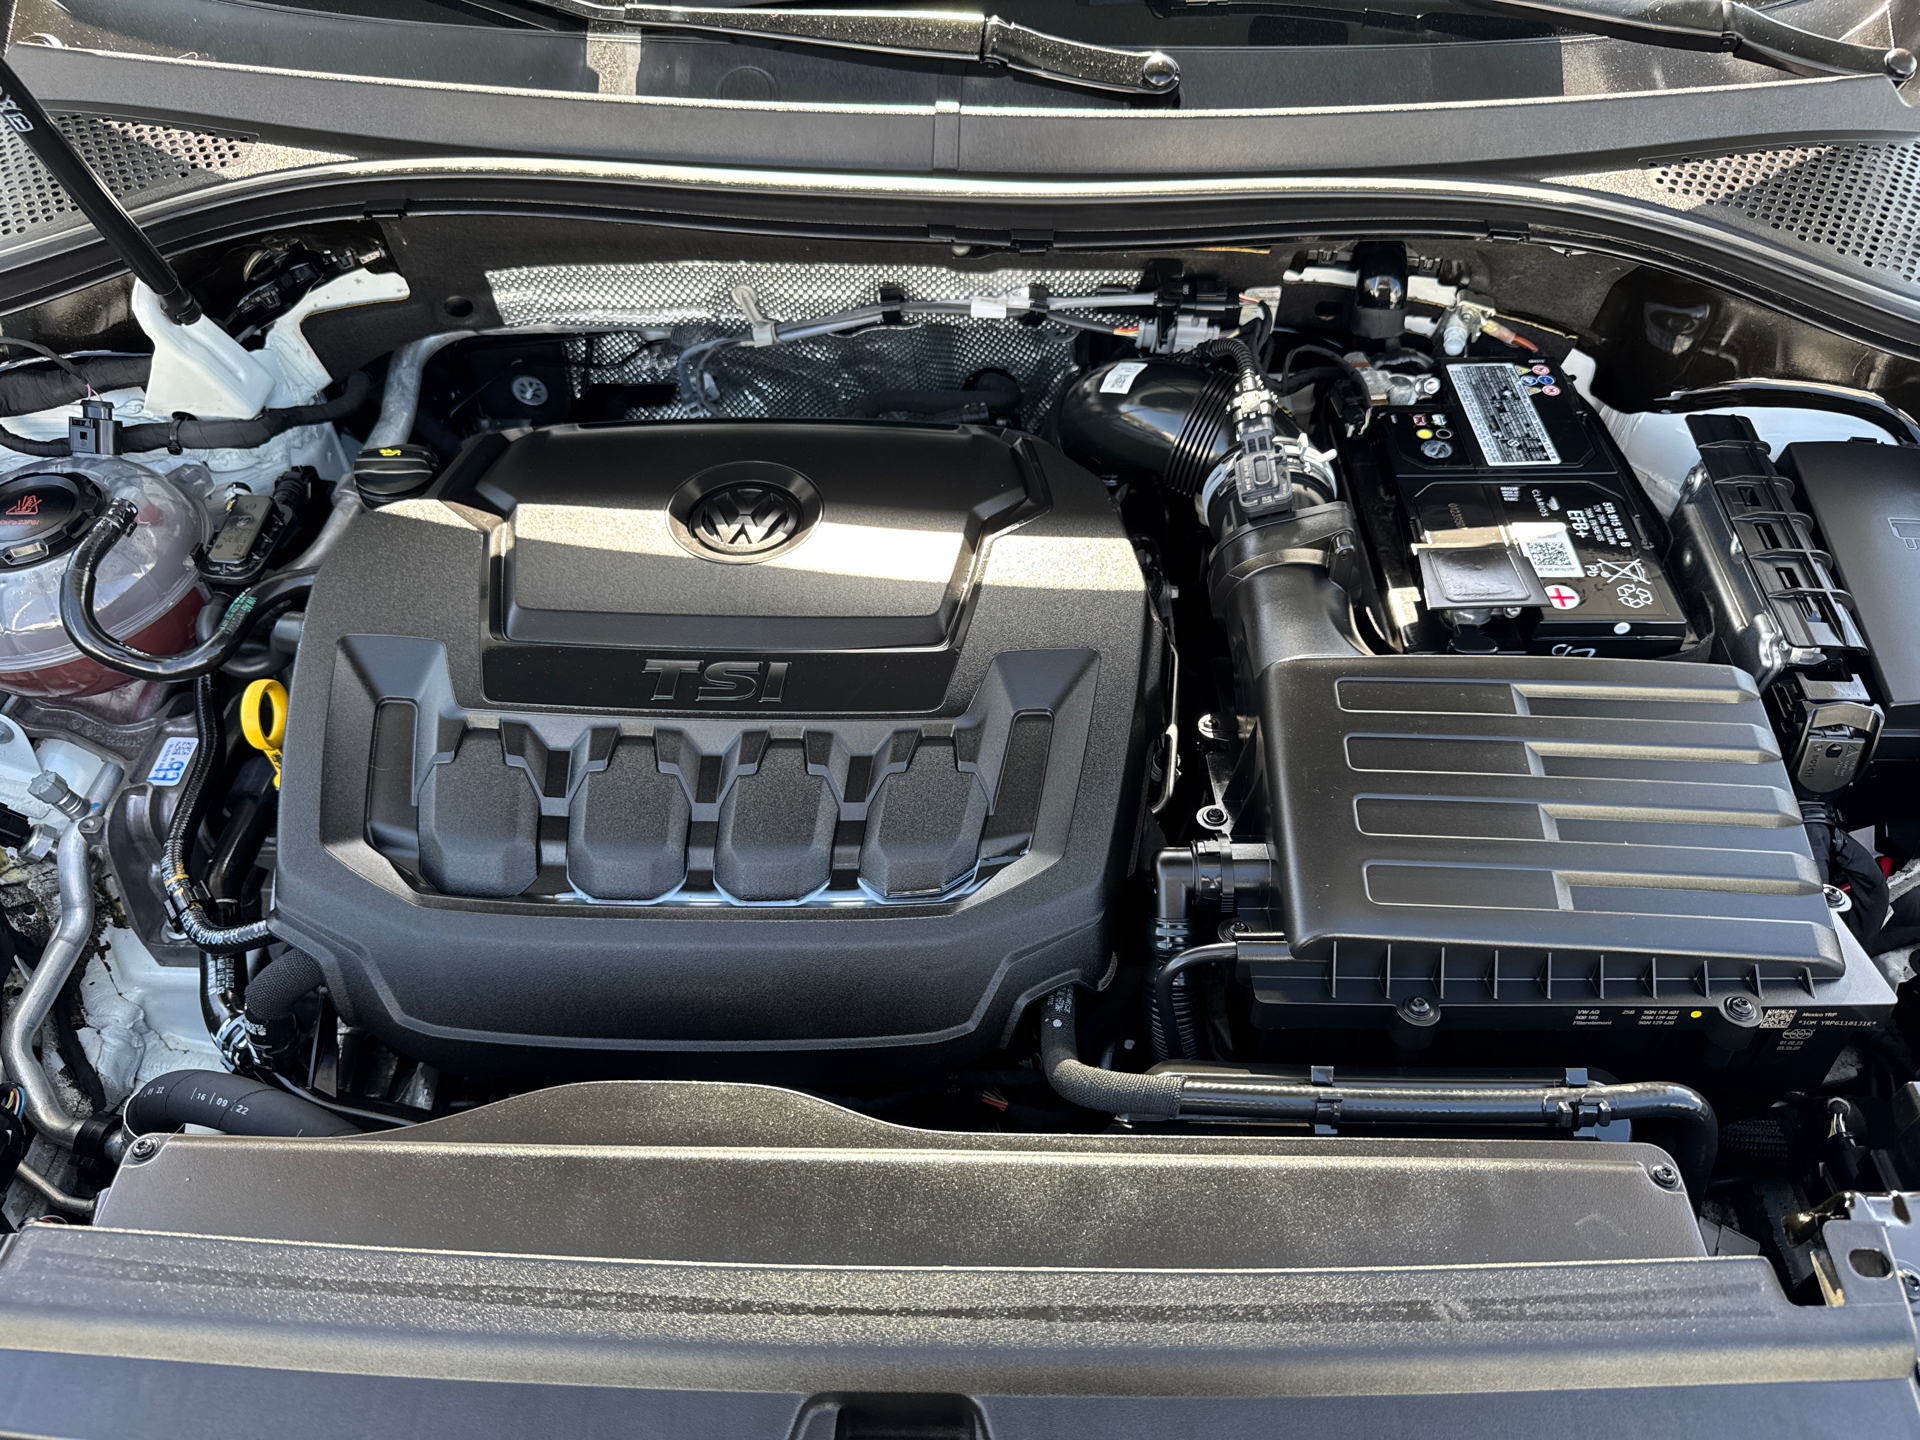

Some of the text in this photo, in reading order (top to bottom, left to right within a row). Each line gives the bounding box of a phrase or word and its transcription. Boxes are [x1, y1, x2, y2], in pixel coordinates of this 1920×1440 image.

[1532, 489, 1550, 517] CLARIOS
[1602, 502, 1616, 514] 5TA
[1566, 510, 1590, 538] EFB+
[1608, 514, 1622, 526] 915
[1614, 528, 1628, 540] 105
[1584, 564, 1600, 577] Pb
[641, 658, 792, 704] TSI
[1805, 755, 1819, 777] BOSCH
[156, 1086, 165, 1094] 22
[197, 1093, 249, 1116] 16 09 22
